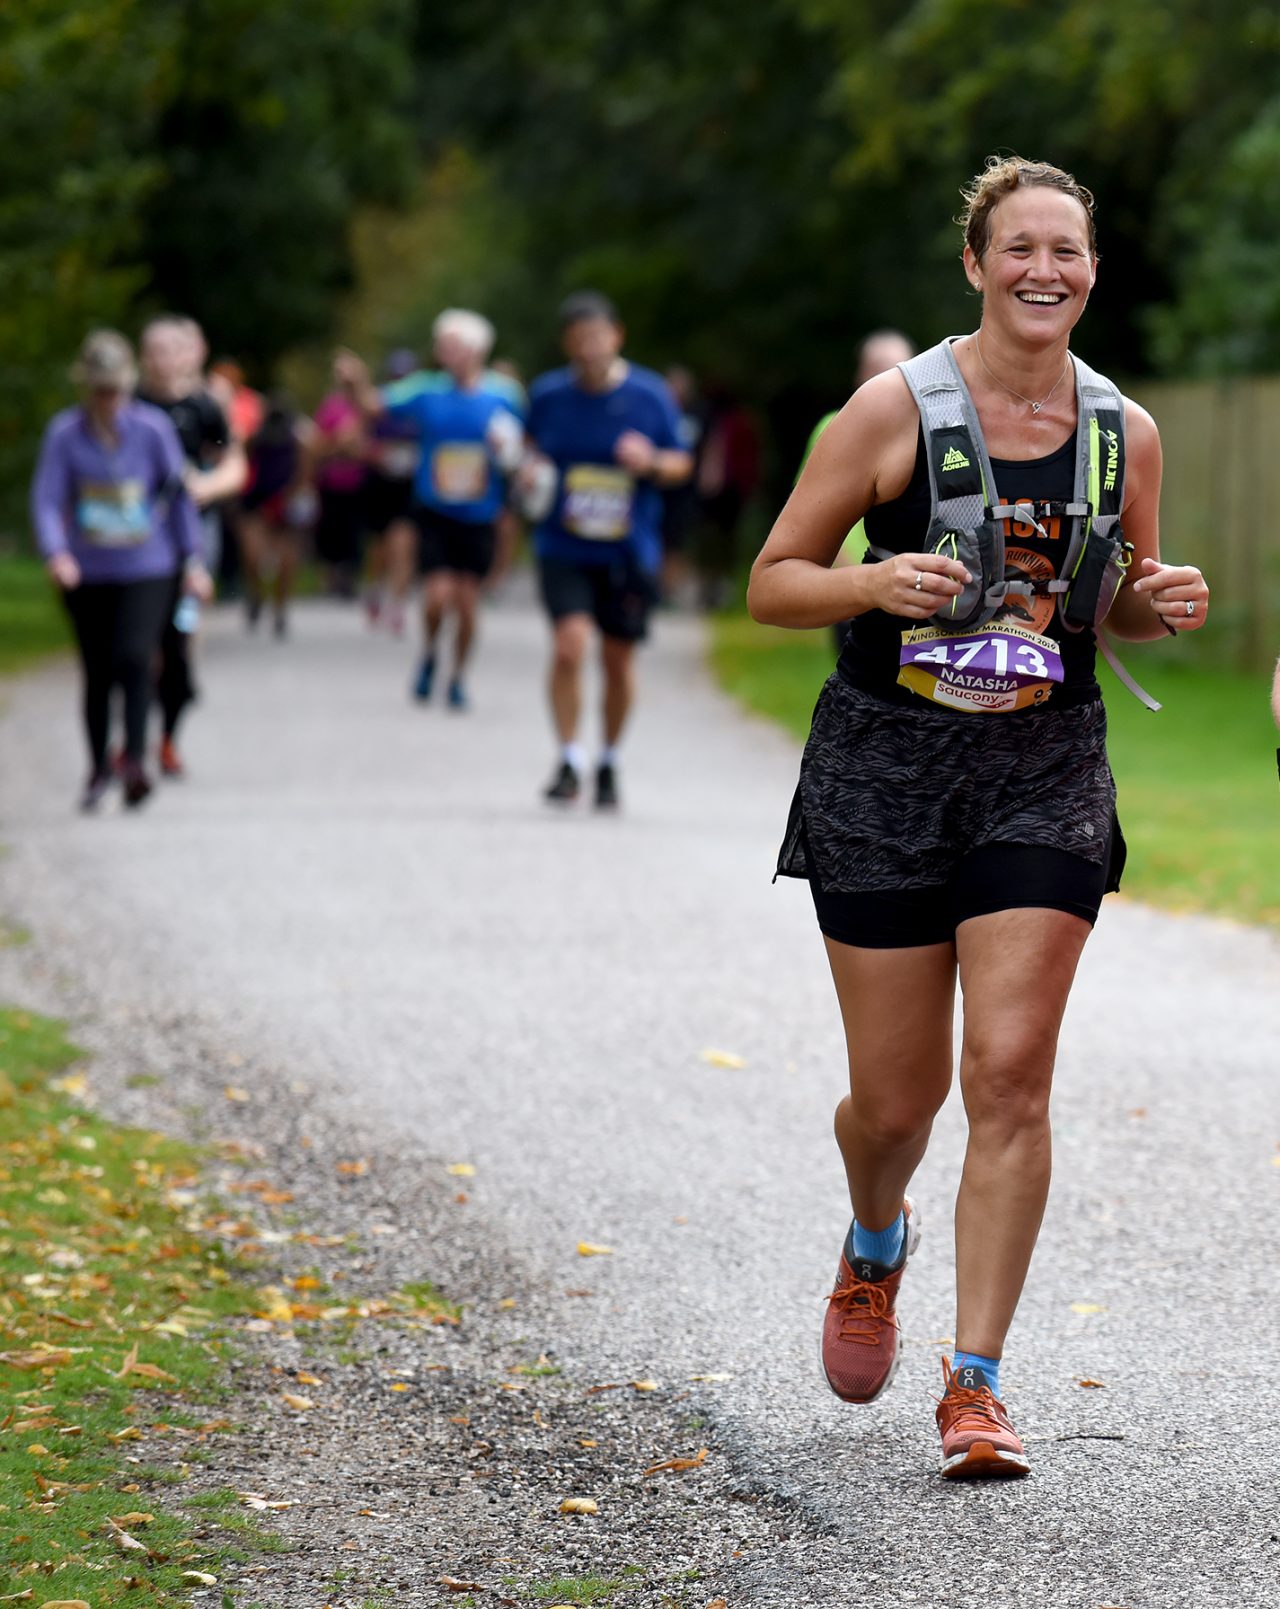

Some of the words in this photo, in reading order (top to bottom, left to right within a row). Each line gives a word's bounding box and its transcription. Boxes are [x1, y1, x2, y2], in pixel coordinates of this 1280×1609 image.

[1103, 428, 1119, 492] AONIJE
[982, 624, 1036, 642] MARATHON
[1037, 637, 1057, 651] 2019
[913, 638, 1049, 678] 4713
[941, 667, 1019, 692] NATASHA
[937, 683, 1000, 704] saucony
